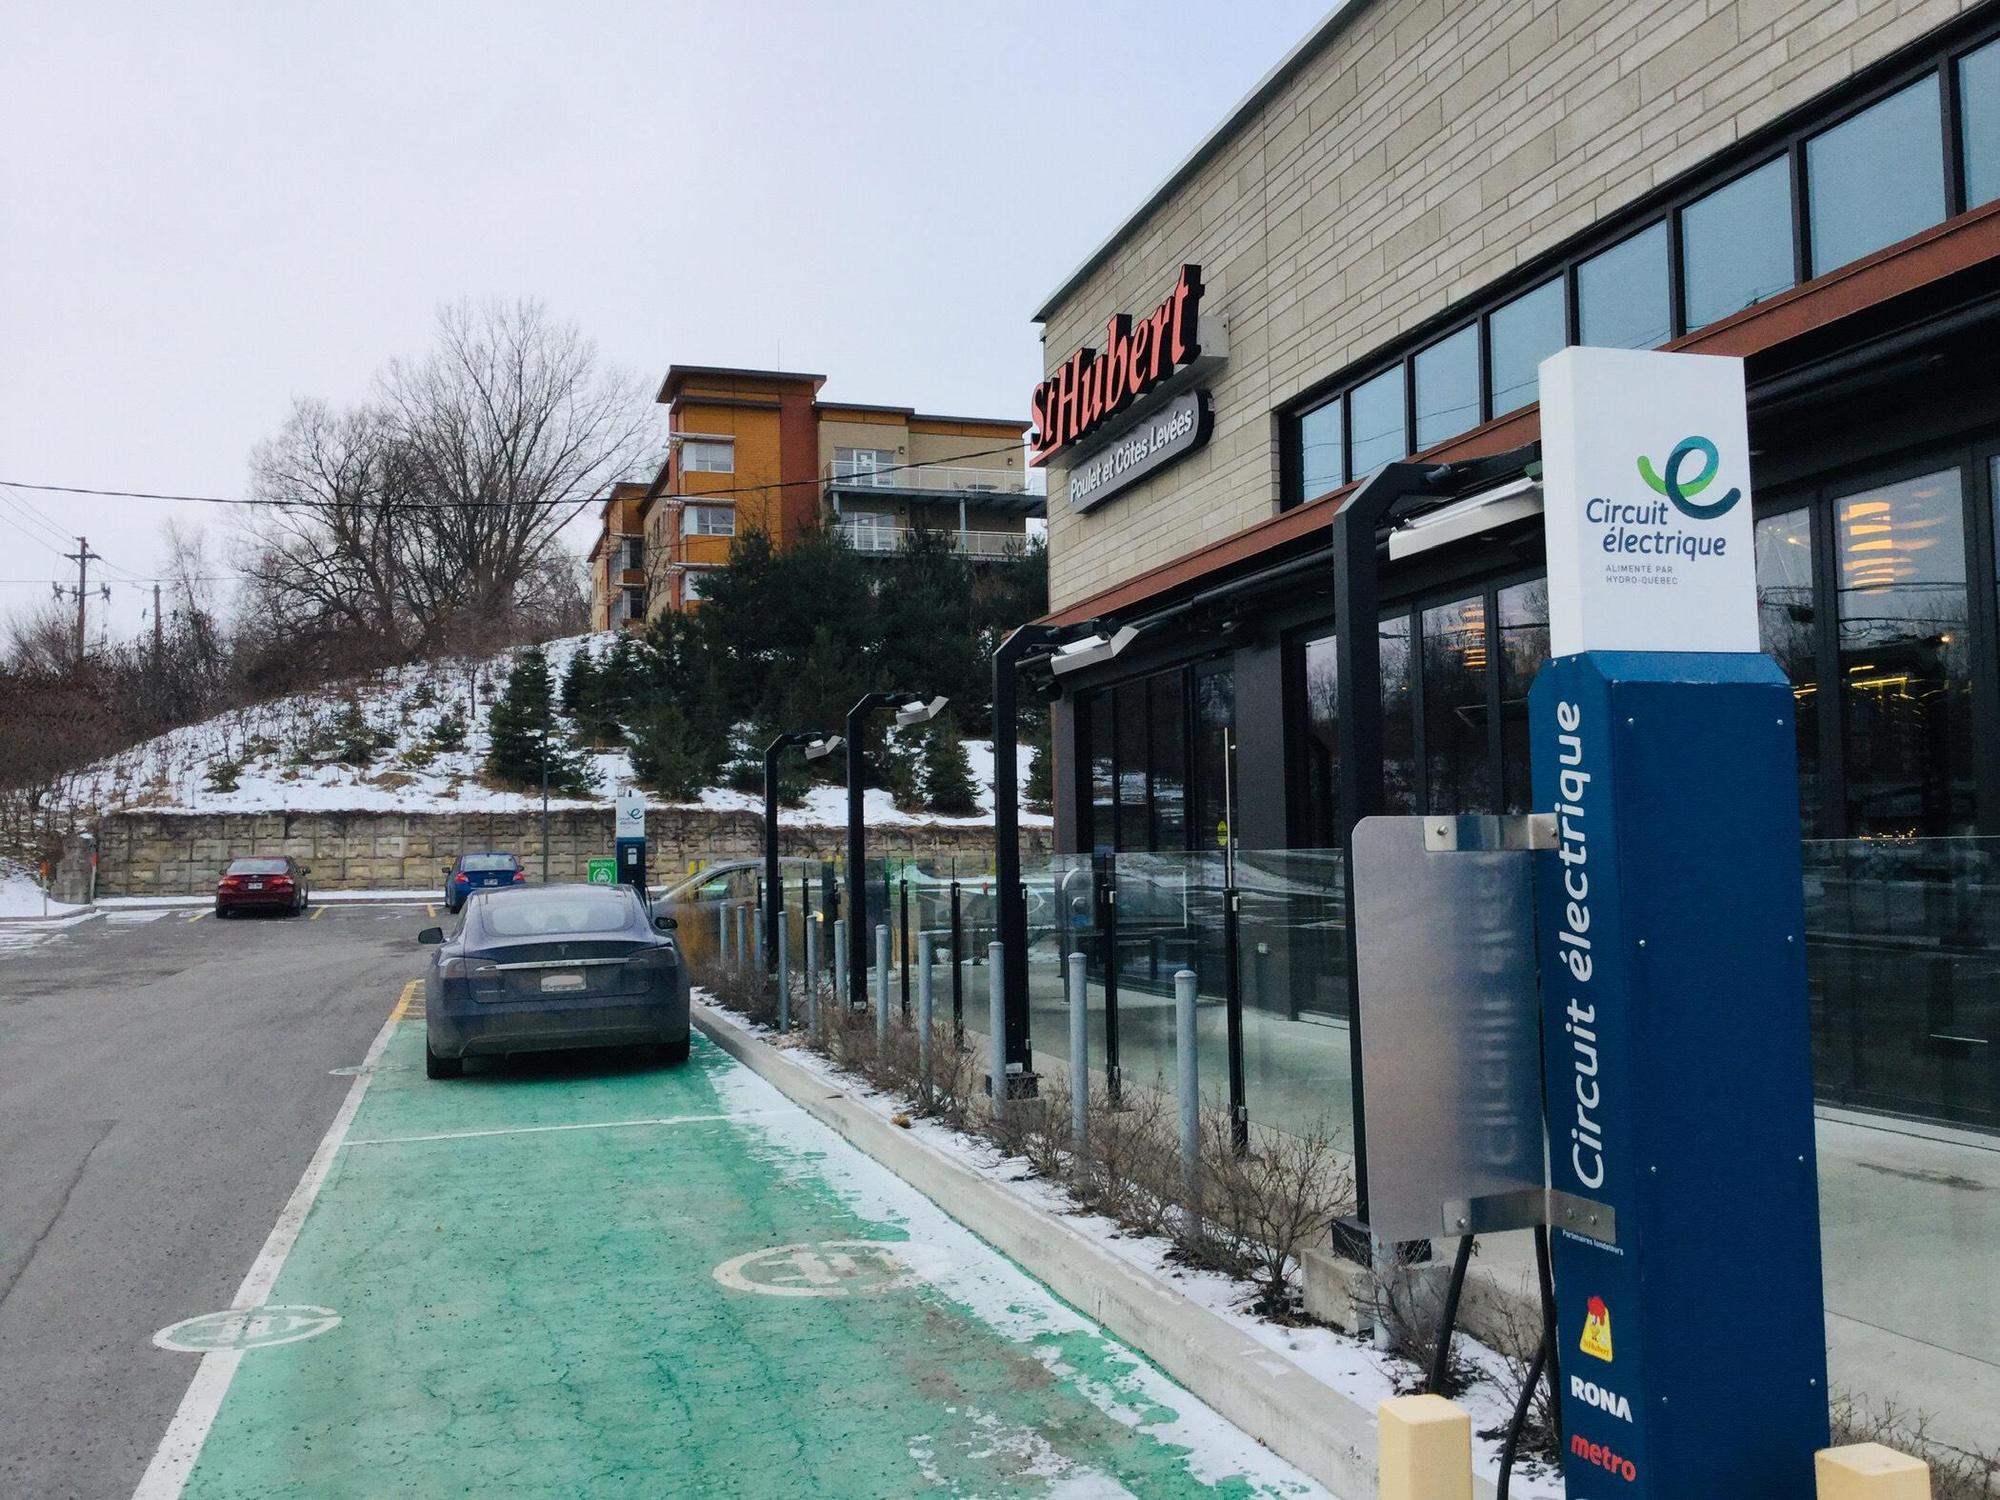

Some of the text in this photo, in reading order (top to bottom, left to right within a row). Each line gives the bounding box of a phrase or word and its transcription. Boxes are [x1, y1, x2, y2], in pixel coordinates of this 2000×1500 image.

[1071, 409, 1194, 502] Poulet et Côtes Levées
[1586, 498, 1669, 525] Circuit
[1602, 527, 1727, 562] électrique
[1655, 565, 1674, 574] PAR
[1554, 700, 1604, 1189] Circuit électrique
[1570, 1374, 1633, 1424] RONA
[1570, 1434, 1637, 1483] metro
